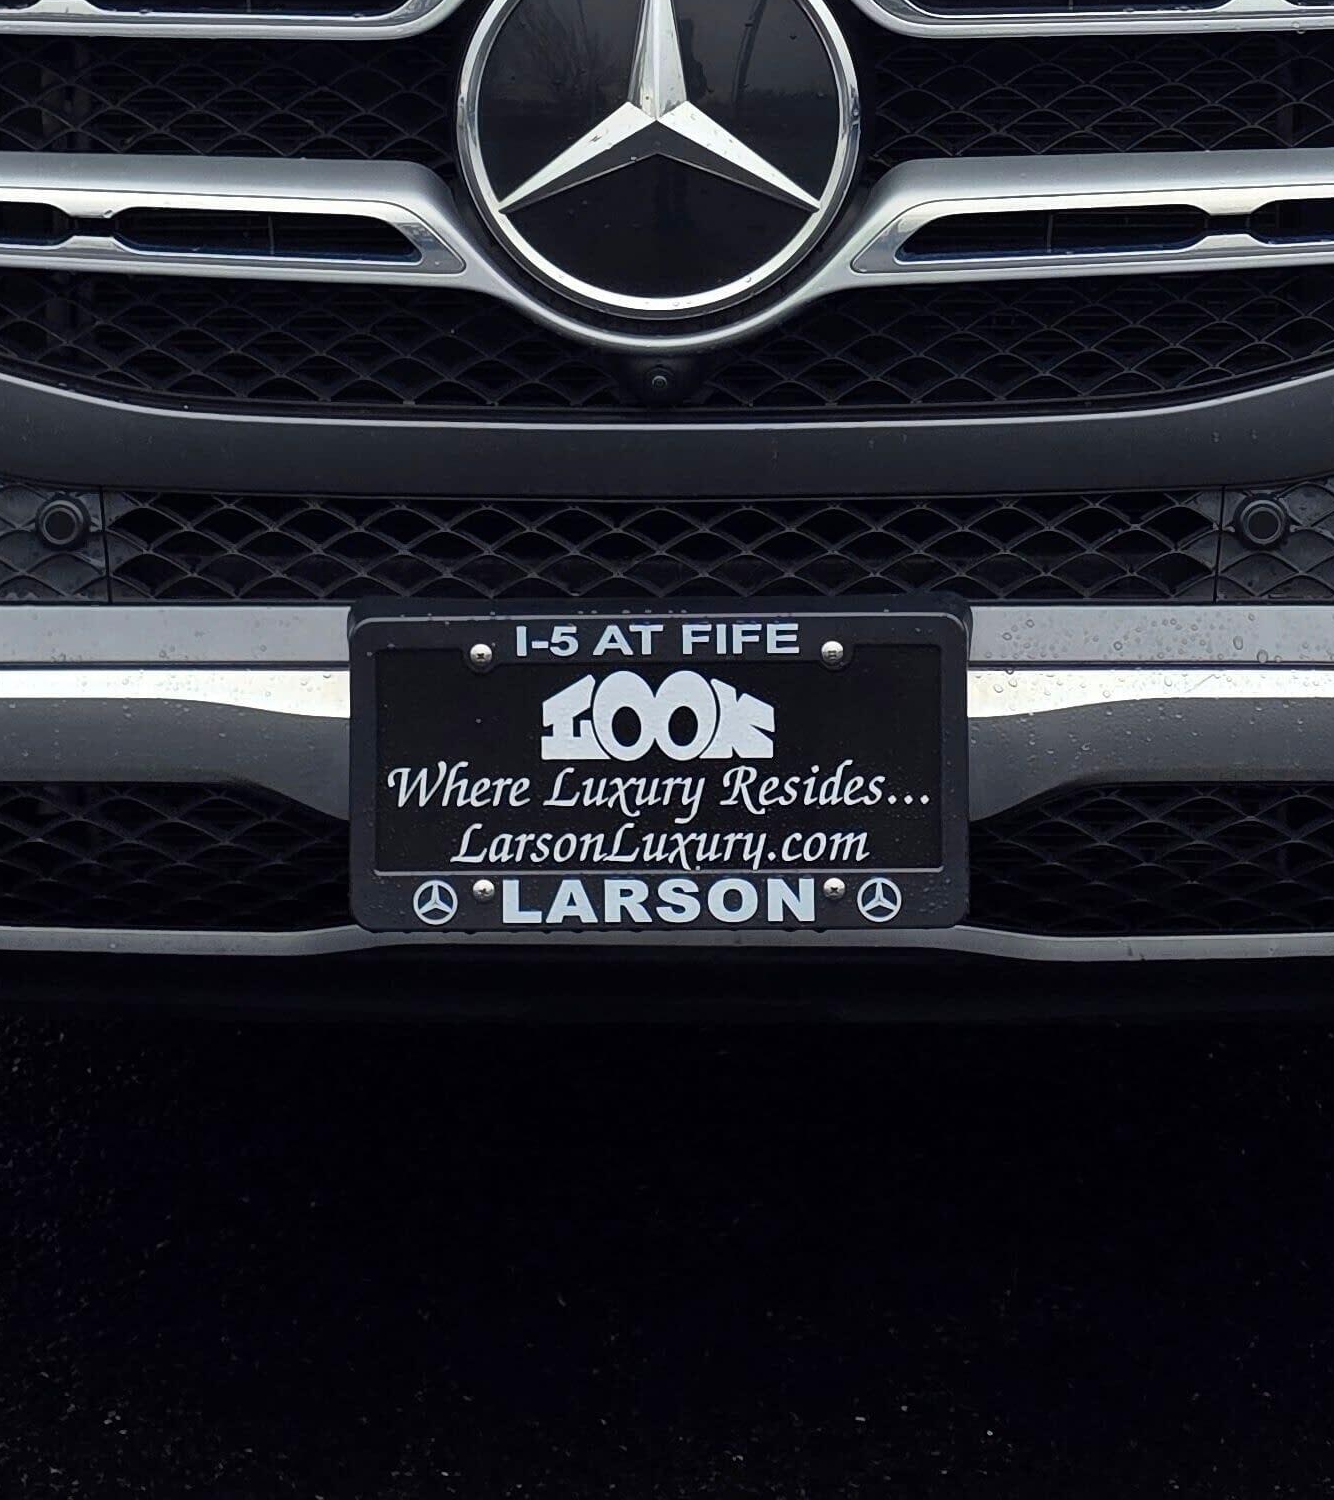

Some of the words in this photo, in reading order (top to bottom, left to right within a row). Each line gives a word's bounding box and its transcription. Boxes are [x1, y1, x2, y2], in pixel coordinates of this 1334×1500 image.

[516, 625, 579, 657] I-5
[592, 623, 664, 656] AT
[682, 623, 800, 654] FIFE
[386, 760, 532, 808] Where
[543, 765, 707, 824] Luxury
[720, 759, 931, 816] Resides...
[450, 823, 871, 871] LarsonLuxury.com
[502, 877, 817, 924] LARSON
